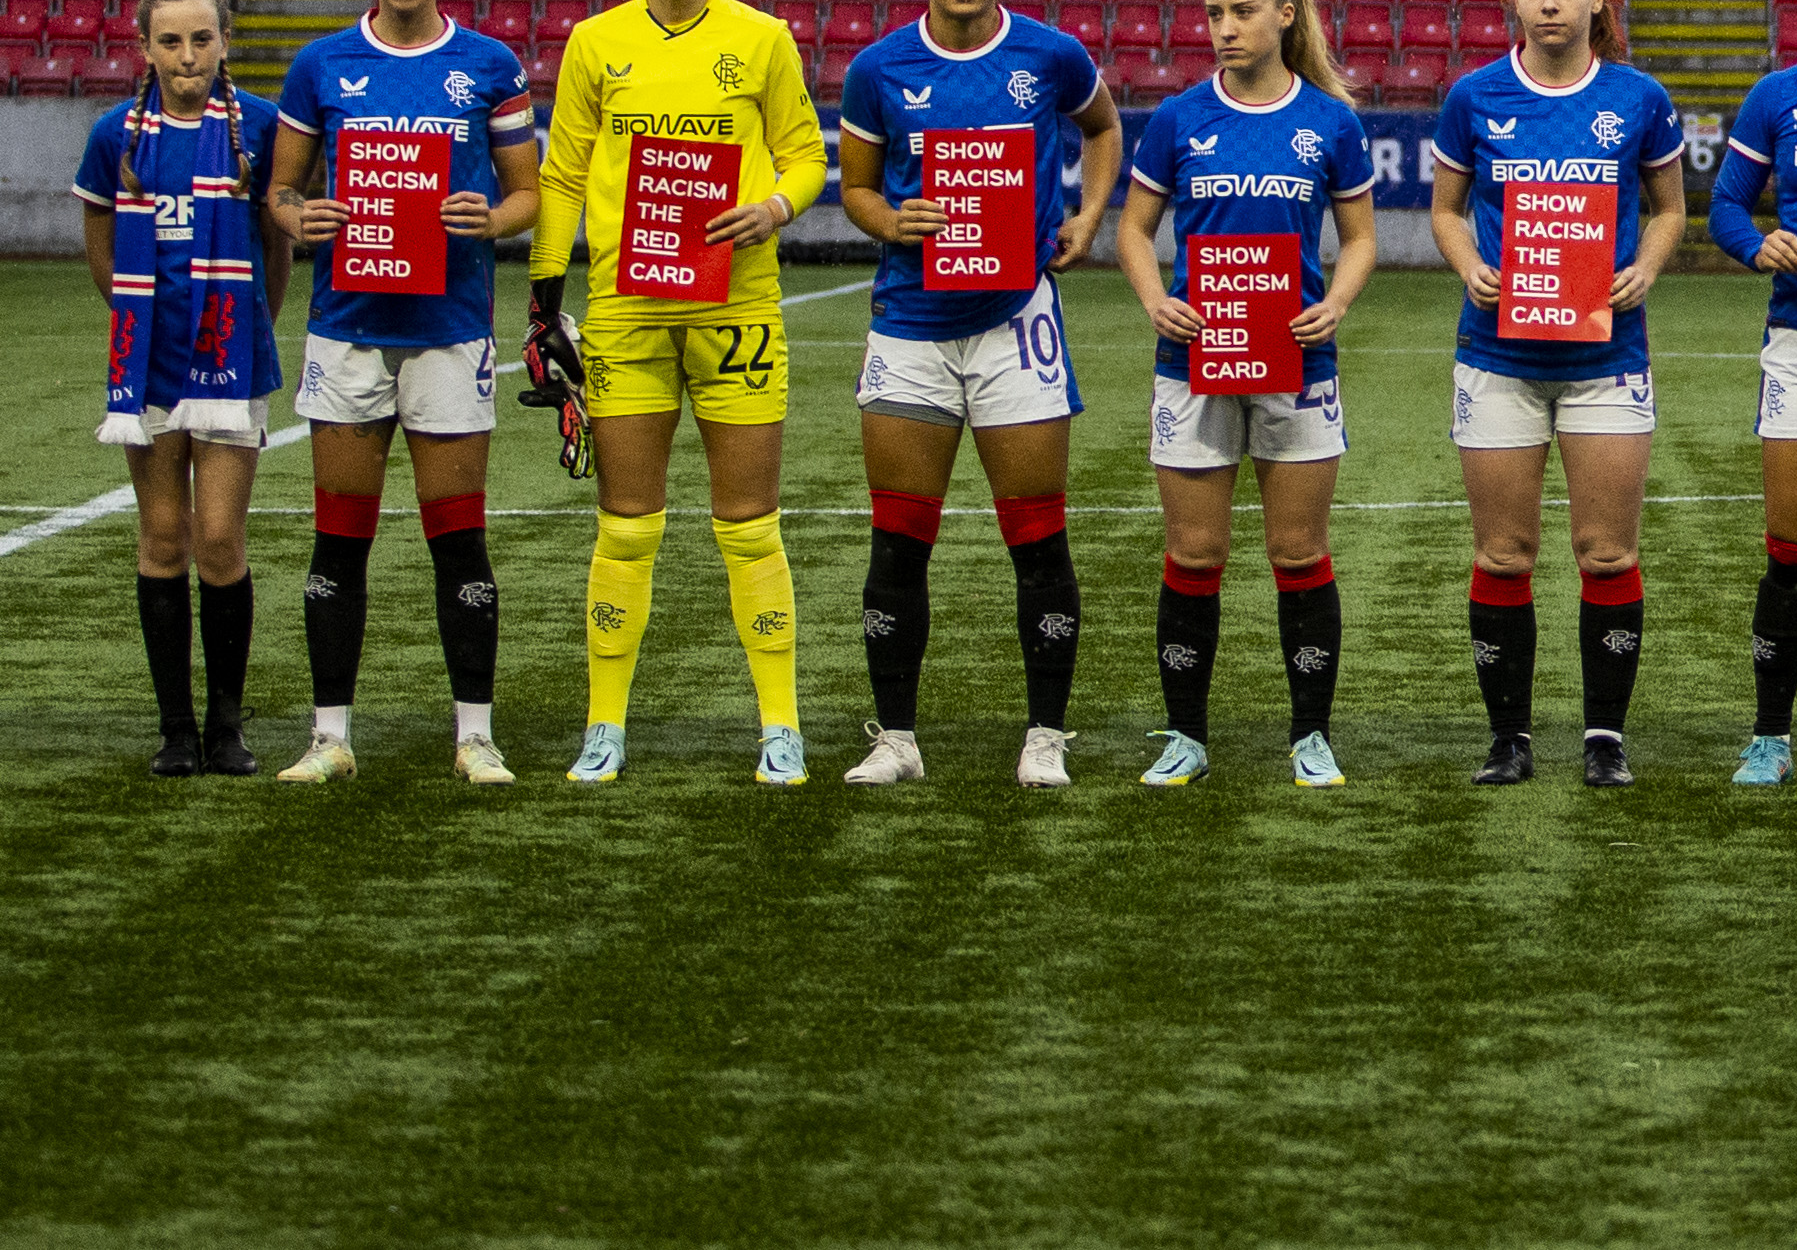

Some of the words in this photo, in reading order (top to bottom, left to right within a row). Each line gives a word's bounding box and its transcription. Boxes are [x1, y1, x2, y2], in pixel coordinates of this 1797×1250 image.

[612, 113, 733, 136] BIOWAVE
[349, 142, 421, 162] SHOW
[640, 148, 712, 172] SHOW
[935, 141, 1005, 160] SHOW
[348, 169, 438, 190] RACISM
[935, 169, 1023, 187] RACISM
[1492, 159, 1619, 182] BIOWAVE
[638, 175, 727, 201] RACISM
[1191, 174, 1314, 202] BIOWAVE
[348, 196, 395, 216] THE
[636, 202, 683, 223] THE
[935, 196, 982, 214] THE
[1515, 192, 1587, 214] SHOW
[346, 224, 394, 243] RED
[632, 228, 680, 250] RED
[935, 223, 982, 241] RED
[1514, 219, 1604, 241] RACISM
[935, 256, 1001, 275] CARD
[1199, 246, 1270, 265] SHOW
[1514, 246, 1561, 266] THE
[345, 258, 411, 278] CARD
[629, 262, 695, 285] CARD
[1200, 273, 1289, 292] RACISM
[1512, 272, 1560, 292] RED
[1201, 301, 1248, 319] THE
[1510, 305, 1577, 326] CARD
[1009, 312, 1059, 370] 10
[1201, 328, 1249, 346] RED
[716, 323, 775, 375] 22
[1202, 361, 1268, 380] CARD
